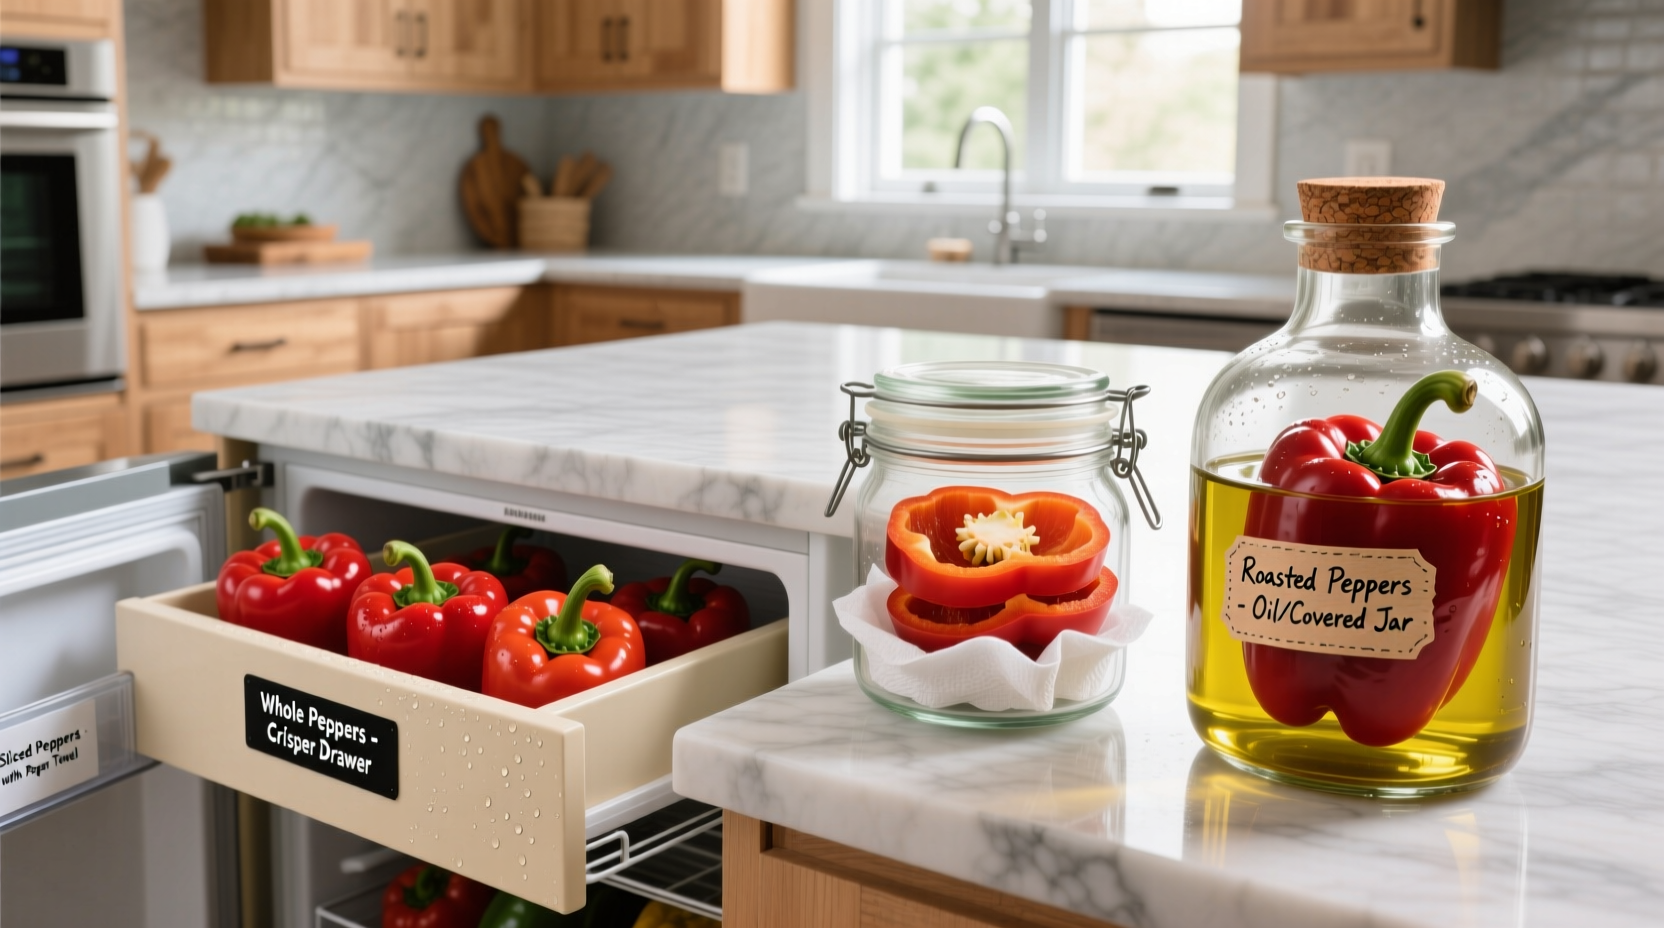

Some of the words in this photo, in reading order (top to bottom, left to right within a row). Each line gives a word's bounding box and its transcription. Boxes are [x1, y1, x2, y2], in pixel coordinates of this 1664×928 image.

[1241, 556, 1317, 591] Roasted
[1328, 566, 1412, 603] Peppers
[1252, 595, 1367, 630] Oil/Covered
[1374, 606, 1413, 632] Jar
[260, 691, 304, 723] Whole
[309, 707, 366, 744] Peppers
[0, 744, 32, 767] Sliced
[36, 729, 81, 754] Peppers
[267, 722, 316, 755] Crisper
[320, 739, 372, 775] Drawer
